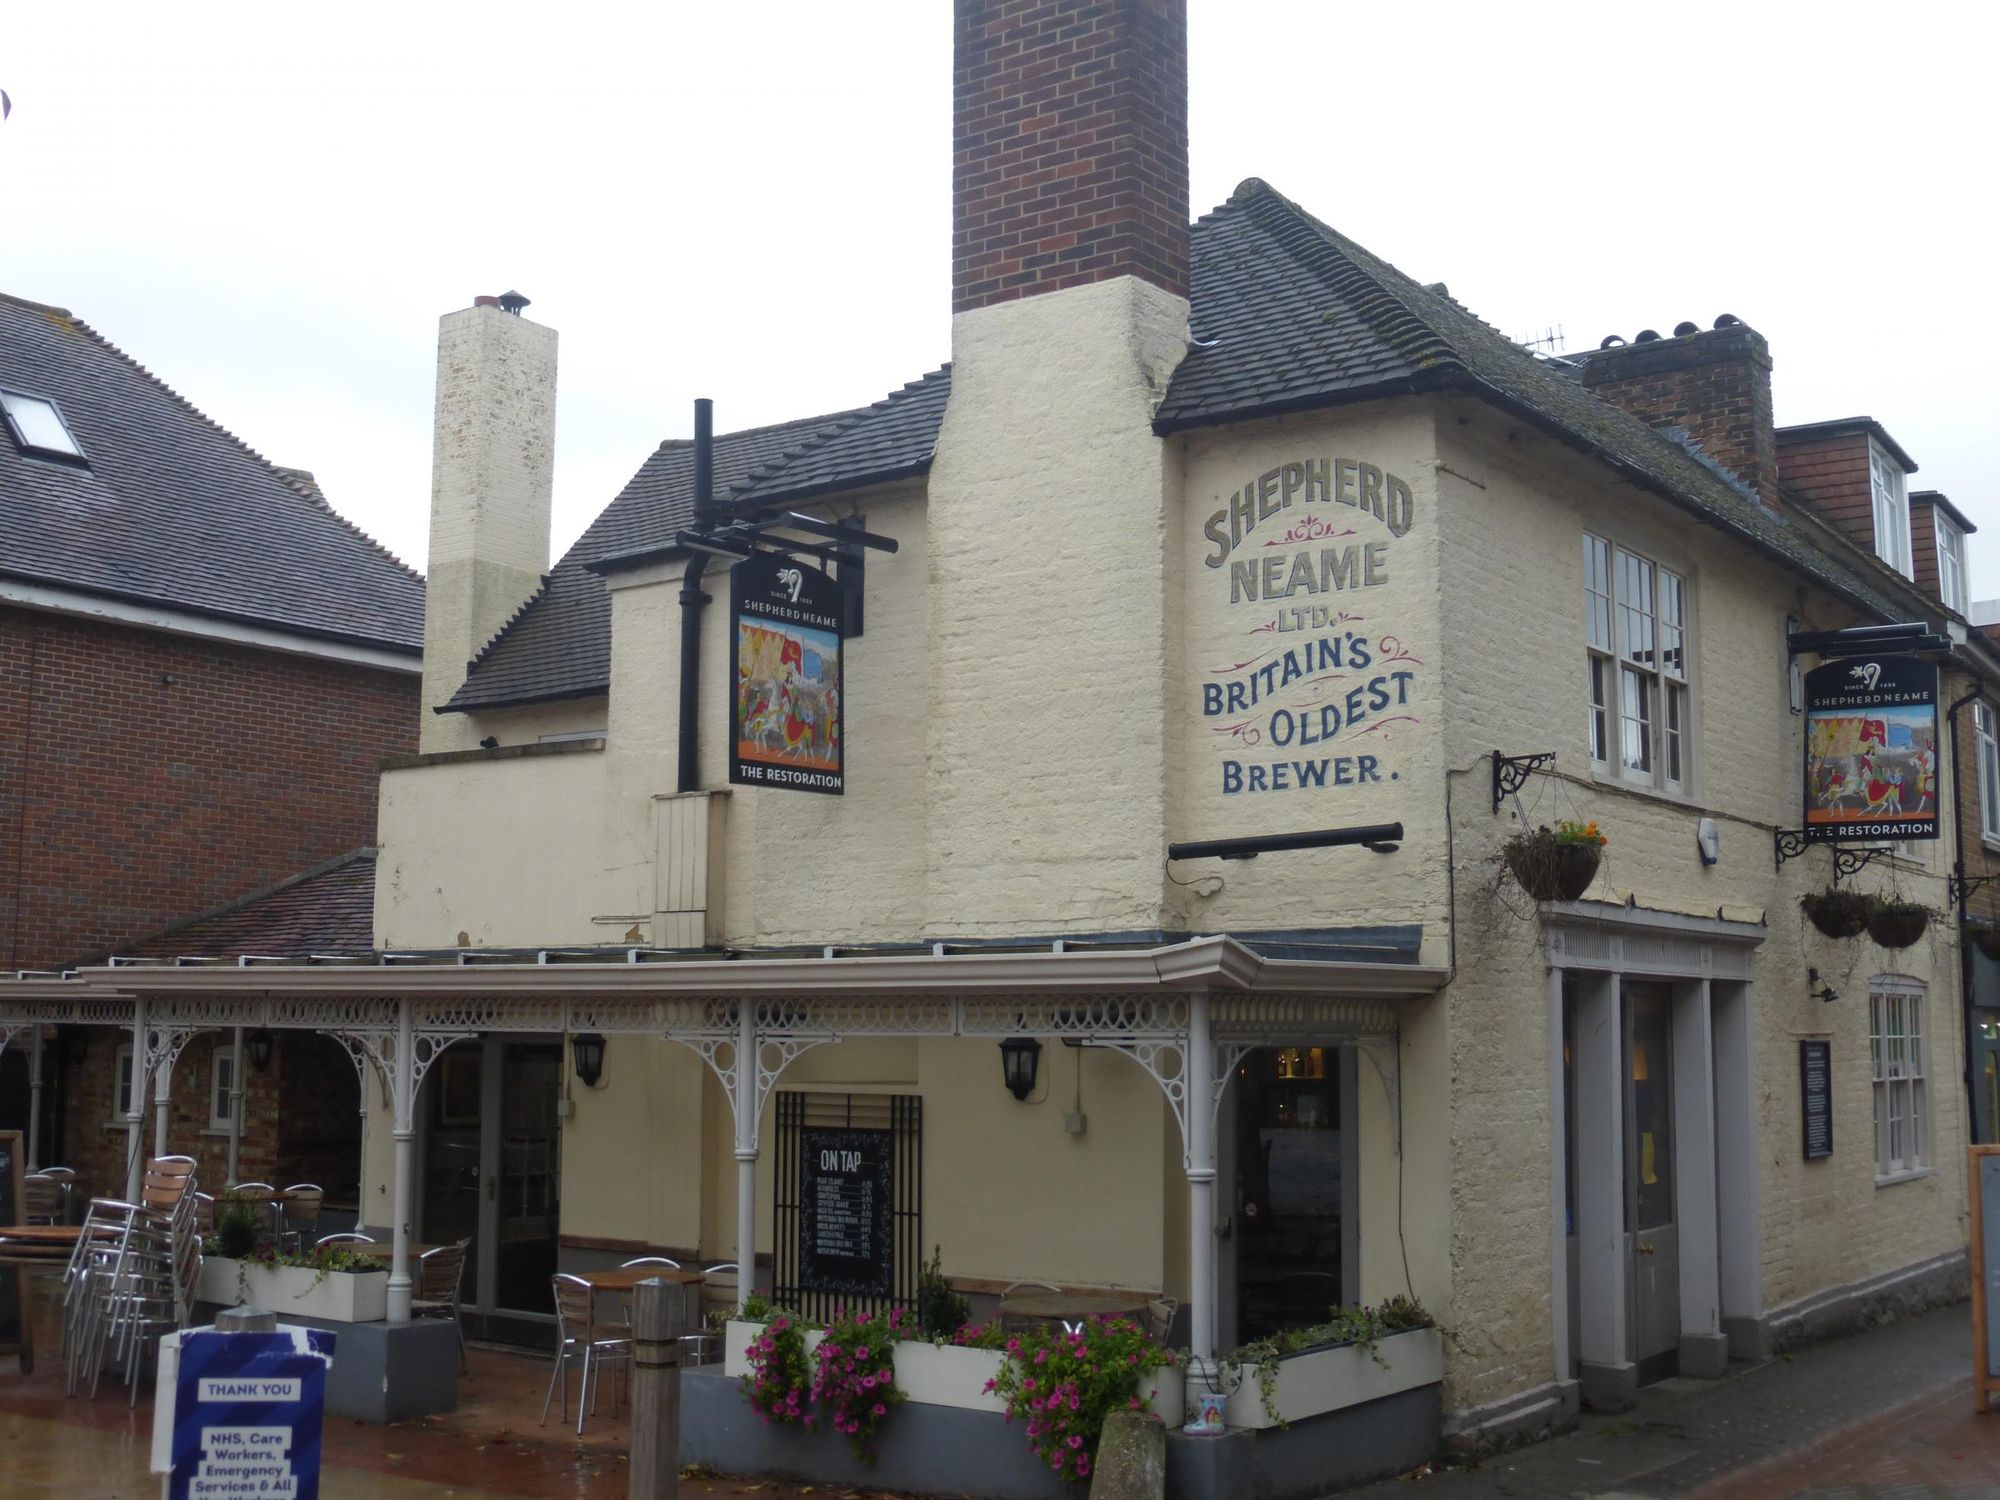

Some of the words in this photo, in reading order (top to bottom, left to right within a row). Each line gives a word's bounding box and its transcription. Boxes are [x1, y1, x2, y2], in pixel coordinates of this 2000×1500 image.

[1204, 458, 1414, 568] SHEPHERD
[1230, 542, 1389, 604] NEAME
[745, 599, 800, 619] SHEPHERD
[803, 612, 838, 628] NEAME
[1278, 606, 1337, 632] LTD.
[1203, 632, 1372, 716] BRITAIN'S
[1269, 672, 1414, 746] OLDEST
[1814, 695, 1881, 706] SHEPHERD
[1884, 691, 1929, 702] NEAME
[740, 765, 763, 780] THE
[767, 767, 842, 788] RESTORATION
[1808, 826, 1834, 837] TE
[1839, 823, 1933, 836] RESTORATION
[820, 1149, 838, 1171] ON
[840, 1150, 862, 1173] TAP
[208, 1384, 257, 1395] THANK
[263, 1384, 291, 1395] YOU
[210, 1433, 245, 1445] NHS,
[250, 1433, 283, 1444] Care
[215, 1449, 277, 1461] Workers,
[206, 1465, 283, 1479] Emergency
[195, 1481, 255, 1492] Services
[260, 1480, 269, 1491] &
[273, 1479, 291, 1491] All
